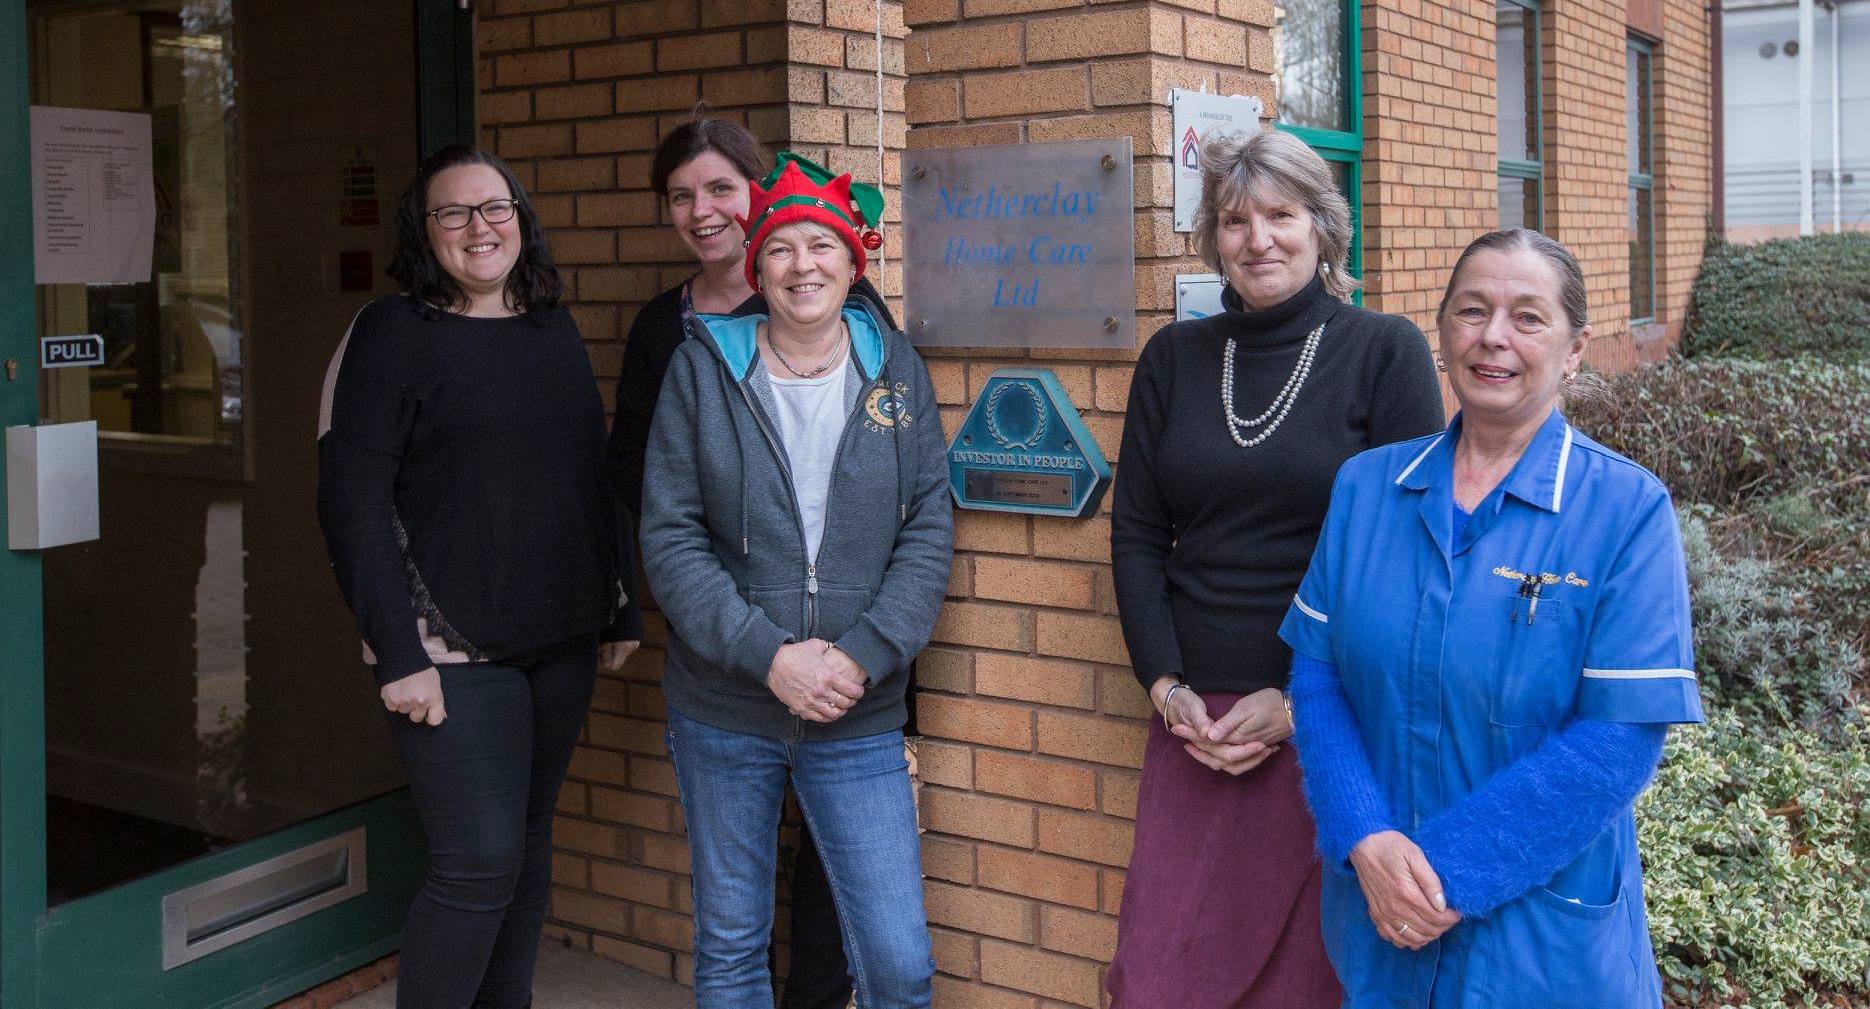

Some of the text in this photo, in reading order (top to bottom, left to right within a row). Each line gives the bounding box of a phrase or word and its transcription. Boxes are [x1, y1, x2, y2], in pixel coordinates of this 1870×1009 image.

[934, 181, 1101, 225] Netherclay
[943, 233, 1092, 266] Home Care
[992, 277, 1040, 308] Ltd
[49, 342, 96, 360] PULL
[953, 451, 1084, 470] INVESTOR IN PEOPLE
